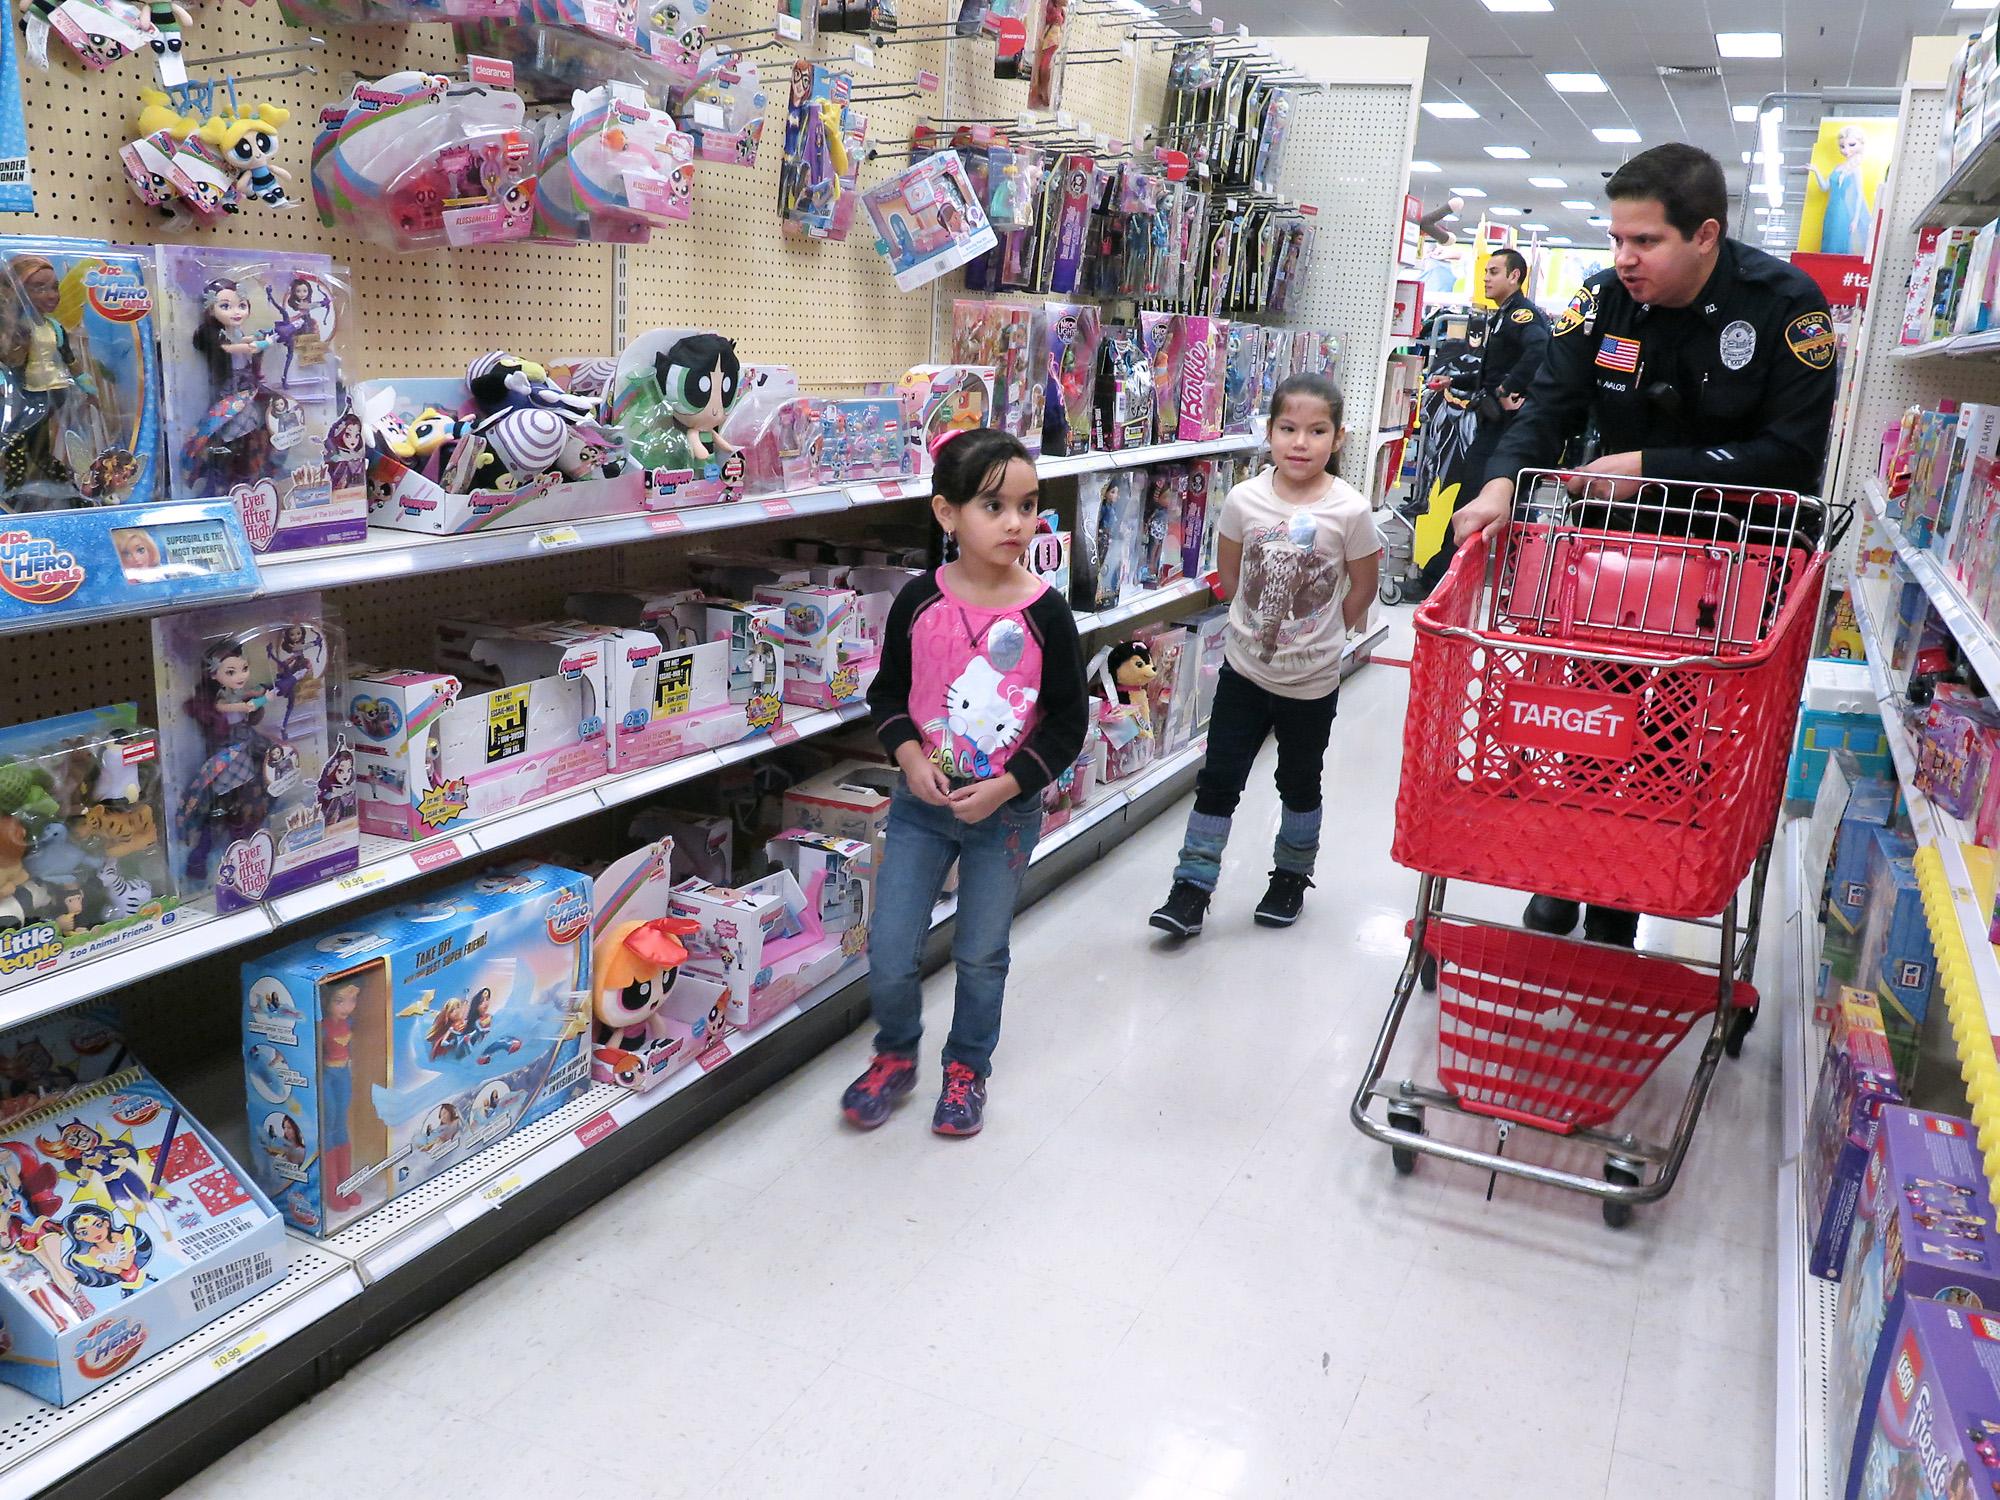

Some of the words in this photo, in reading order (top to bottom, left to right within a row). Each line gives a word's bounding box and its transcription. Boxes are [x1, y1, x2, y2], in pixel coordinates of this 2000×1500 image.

[475, 65, 511, 79] clearance
[0, 160, 25, 172] ONDER
[0, 171, 25, 182] OMAN
[104, 286, 148, 302] HERO
[1796, 316, 1823, 330] POLICE
[1180, 341, 1209, 416] Barbie
[241, 491, 266, 510] Ever
[243, 507, 271, 527] After
[10, 532, 29, 545] DC
[166, 533, 202, 545] SUPERGIRL
[203, 533, 210, 542] IS
[211, 531, 224, 541] THE
[246, 523, 273, 542] High
[0, 541, 52, 561] UPER
[171, 547, 190, 557] MOST
[15, 554, 73, 579] HERO
[41, 567, 82, 585] GIRLS
[238, 845, 261, 864] Ever
[417, 846, 457, 866] clearance
[239, 859, 265, 879] After
[242, 874, 269, 895] High
[339, 875, 365, 890] 19.99
[557, 905, 589, 929] HERO
[69, 948, 88, 960] Zoo
[89, 937, 120, 952] Animal
[122, 923, 154, 940] Friends
[582, 1119, 614, 1142] clearance
[230, 1216, 244, 1226] SET
[190, 1286, 204, 1301] KIT
[204, 1282, 215, 1295] DE
[215, 1270, 244, 1290] DESSINS
[245, 1265, 253, 1276] DE
[254, 1257, 272, 1272] MODE
[192, 1266, 225, 1287] FASHION
[225, 1257, 252, 1274] SKETCH
[253, 1251, 265, 1263] SET
[193, 1298, 207, 1312] KIT
[207, 1293, 217, 1306] DE
[246, 1275, 254, 1286] DE
[255, 1266, 273, 1281] MODA
[94, 1322, 142, 1363] HERO
[214, 1347, 241, 1367] 10.99
[1896, 1350, 1915, 1401] LEGO
[1908, 1384, 1949, 1498] Friends
